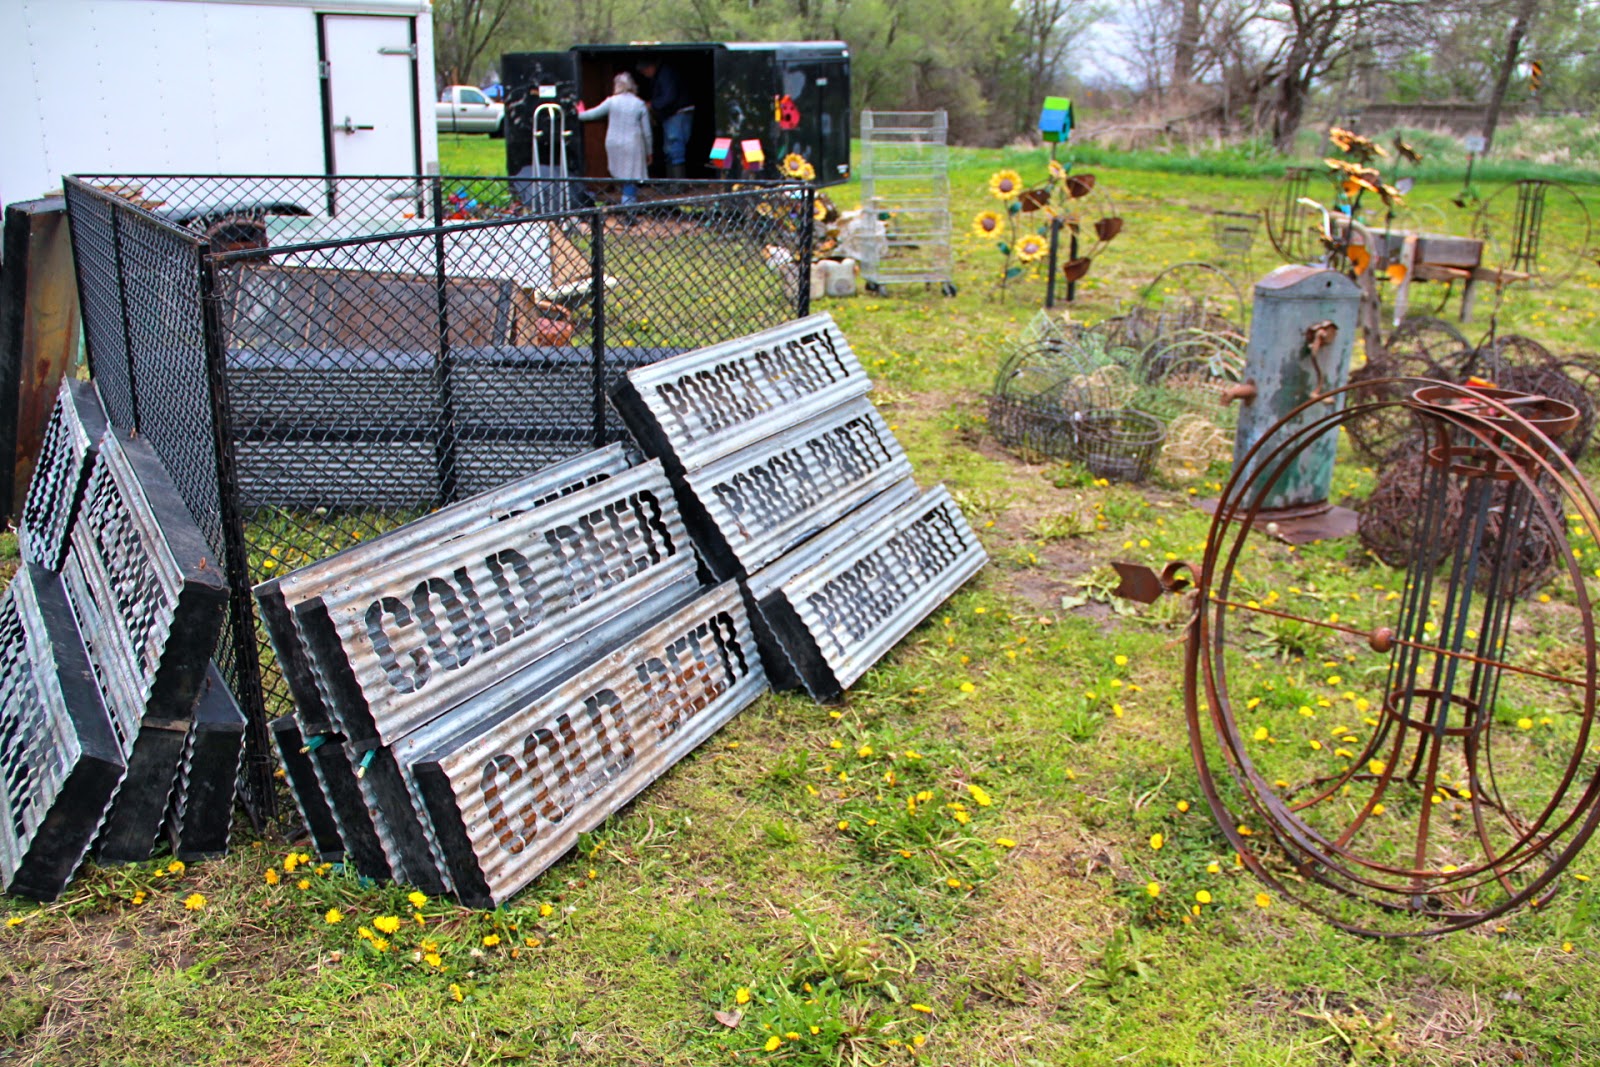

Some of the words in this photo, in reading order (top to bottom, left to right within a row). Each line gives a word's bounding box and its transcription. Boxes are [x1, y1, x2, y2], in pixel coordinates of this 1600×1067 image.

[656, 357, 773, 442] PORCH
[755, 328, 850, 402] PARTY
[712, 447, 823, 540] PORCH
[806, 413, 892, 492] PARTY
[364, 547, 544, 695] COLD
[544, 489, 676, 608] BEER
[806, 550, 906, 656] PORCH
[887, 502, 967, 591] PARTY
[479, 687, 636, 857] COLD
[636, 609, 749, 741] BEER
